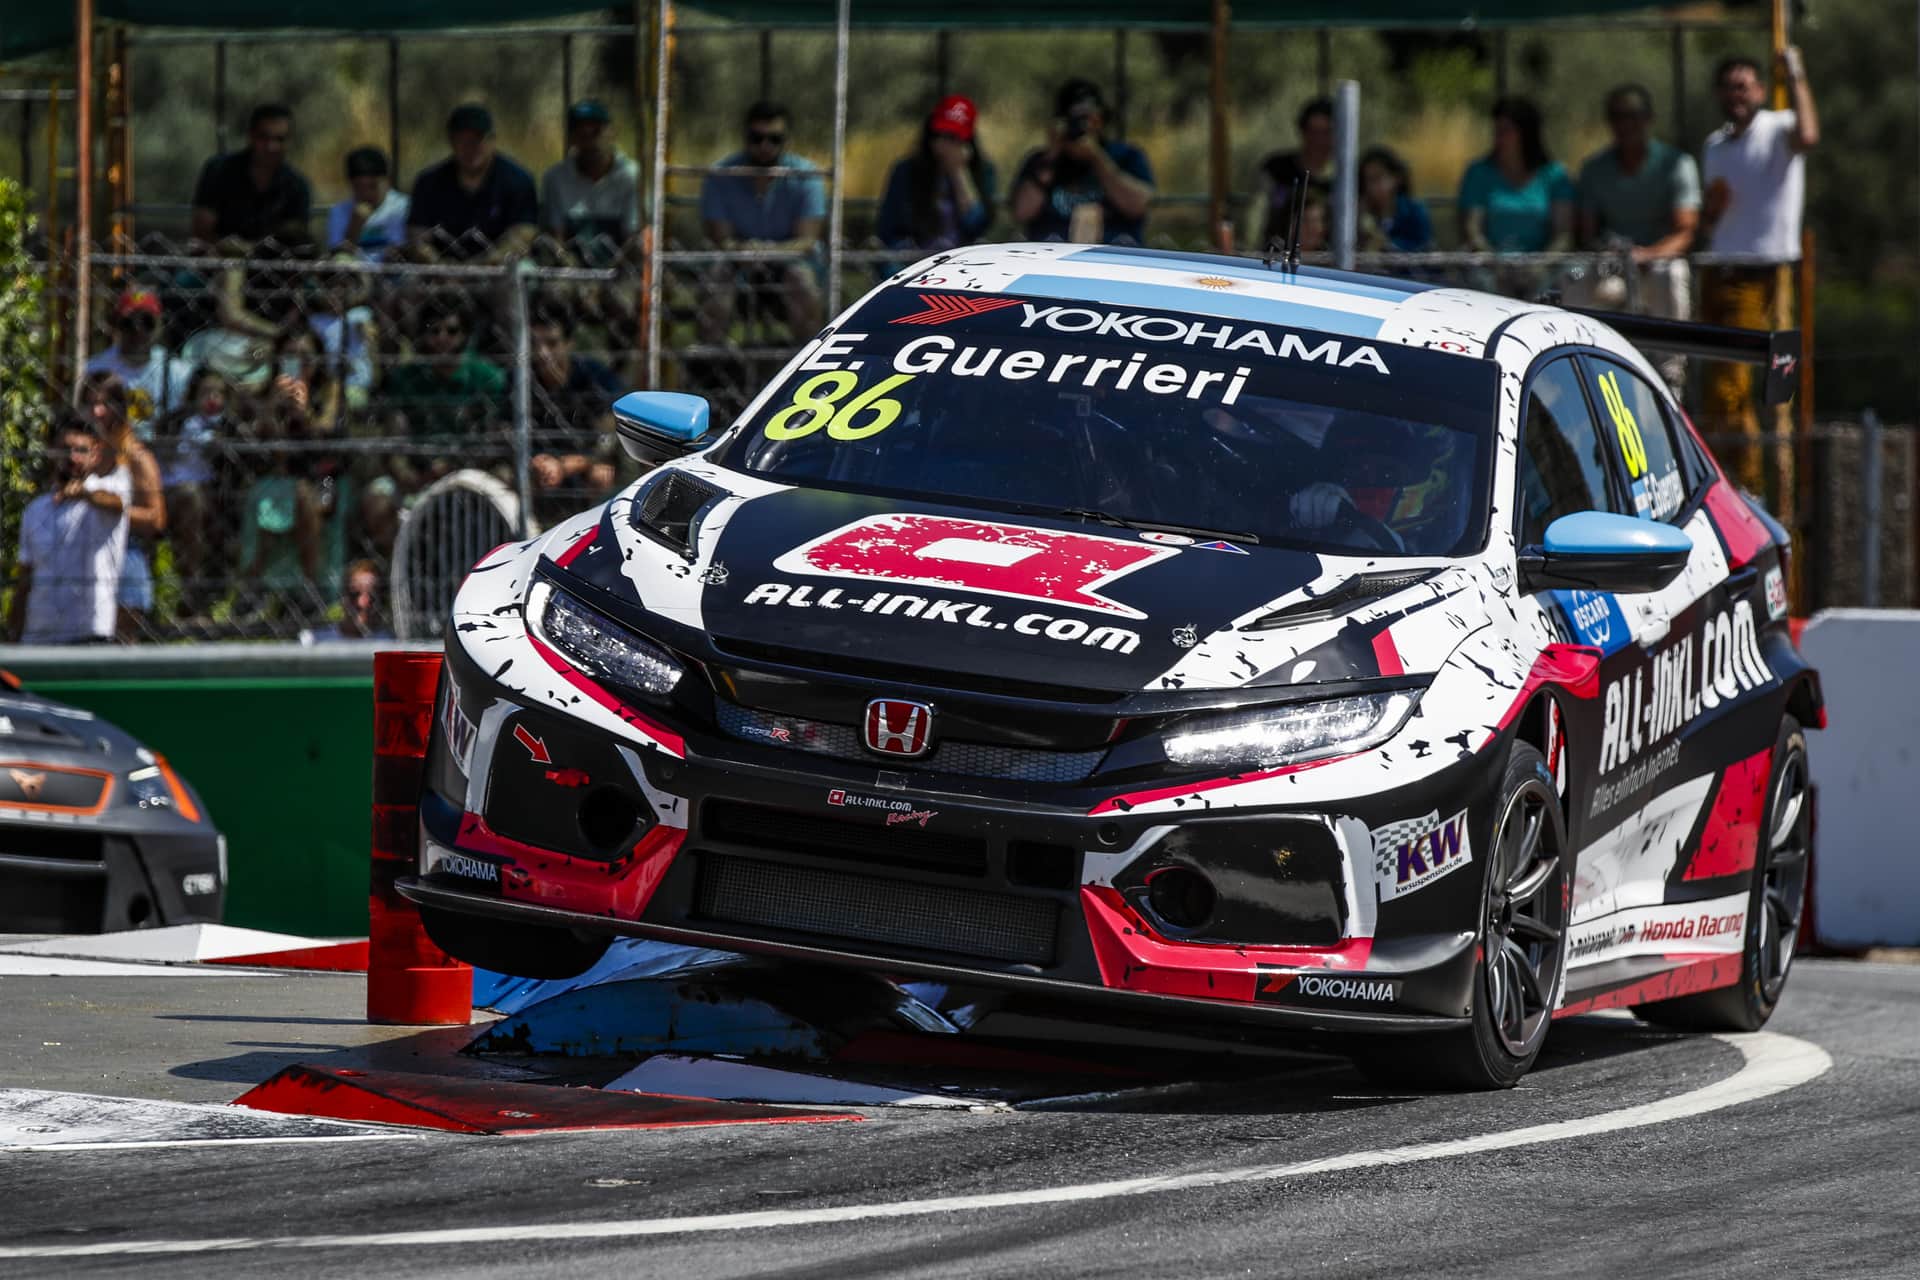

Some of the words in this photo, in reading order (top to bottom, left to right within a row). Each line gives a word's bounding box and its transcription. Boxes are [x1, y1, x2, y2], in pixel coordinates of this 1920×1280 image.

[799, 333, 868, 370] E.
[893, 335, 1250, 405] Guerrieri
[1020, 303, 1391, 375] YOKOHAMA
[763, 370, 917, 441] 86
[1598, 371, 1648, 478] 86
[1395, 814, 1465, 884] KW
[1639, 918, 1693, 943] Honda
[1696, 912, 1744, 938] Racing
[1298, 975, 1394, 1001] YOKOHAMA
